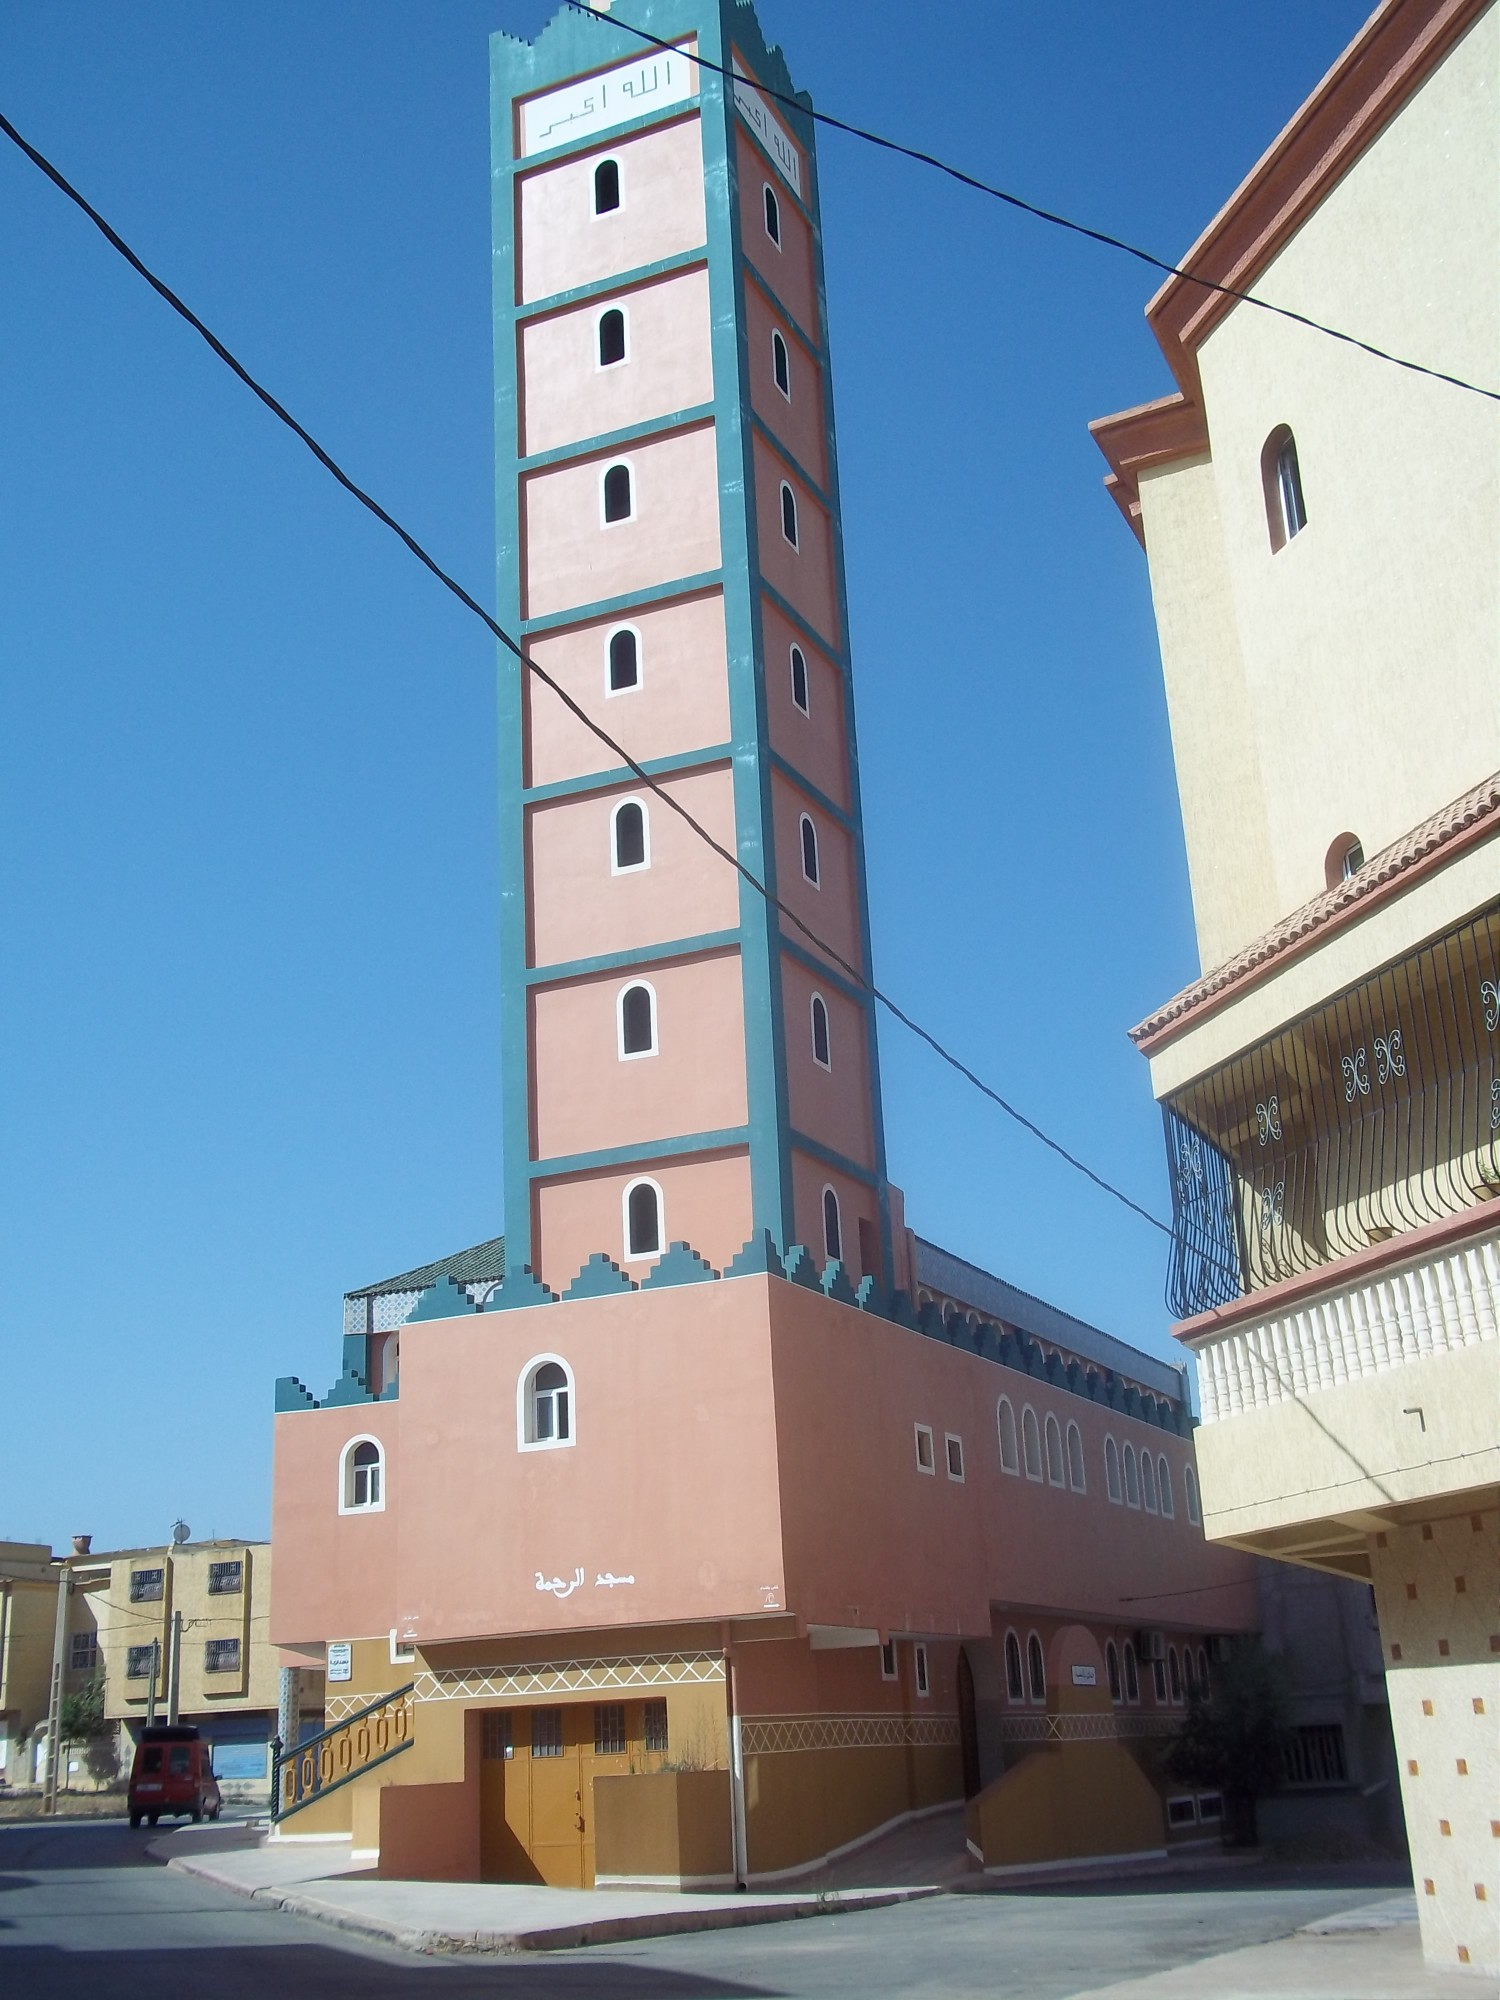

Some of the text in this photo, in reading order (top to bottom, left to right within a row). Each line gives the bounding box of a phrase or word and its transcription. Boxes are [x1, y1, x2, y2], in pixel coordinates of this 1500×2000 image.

[622, 60, 671, 99] الله
[773, 132, 797, 182] الله
[534, 1566, 635, 1599] مسجد الرحمة
